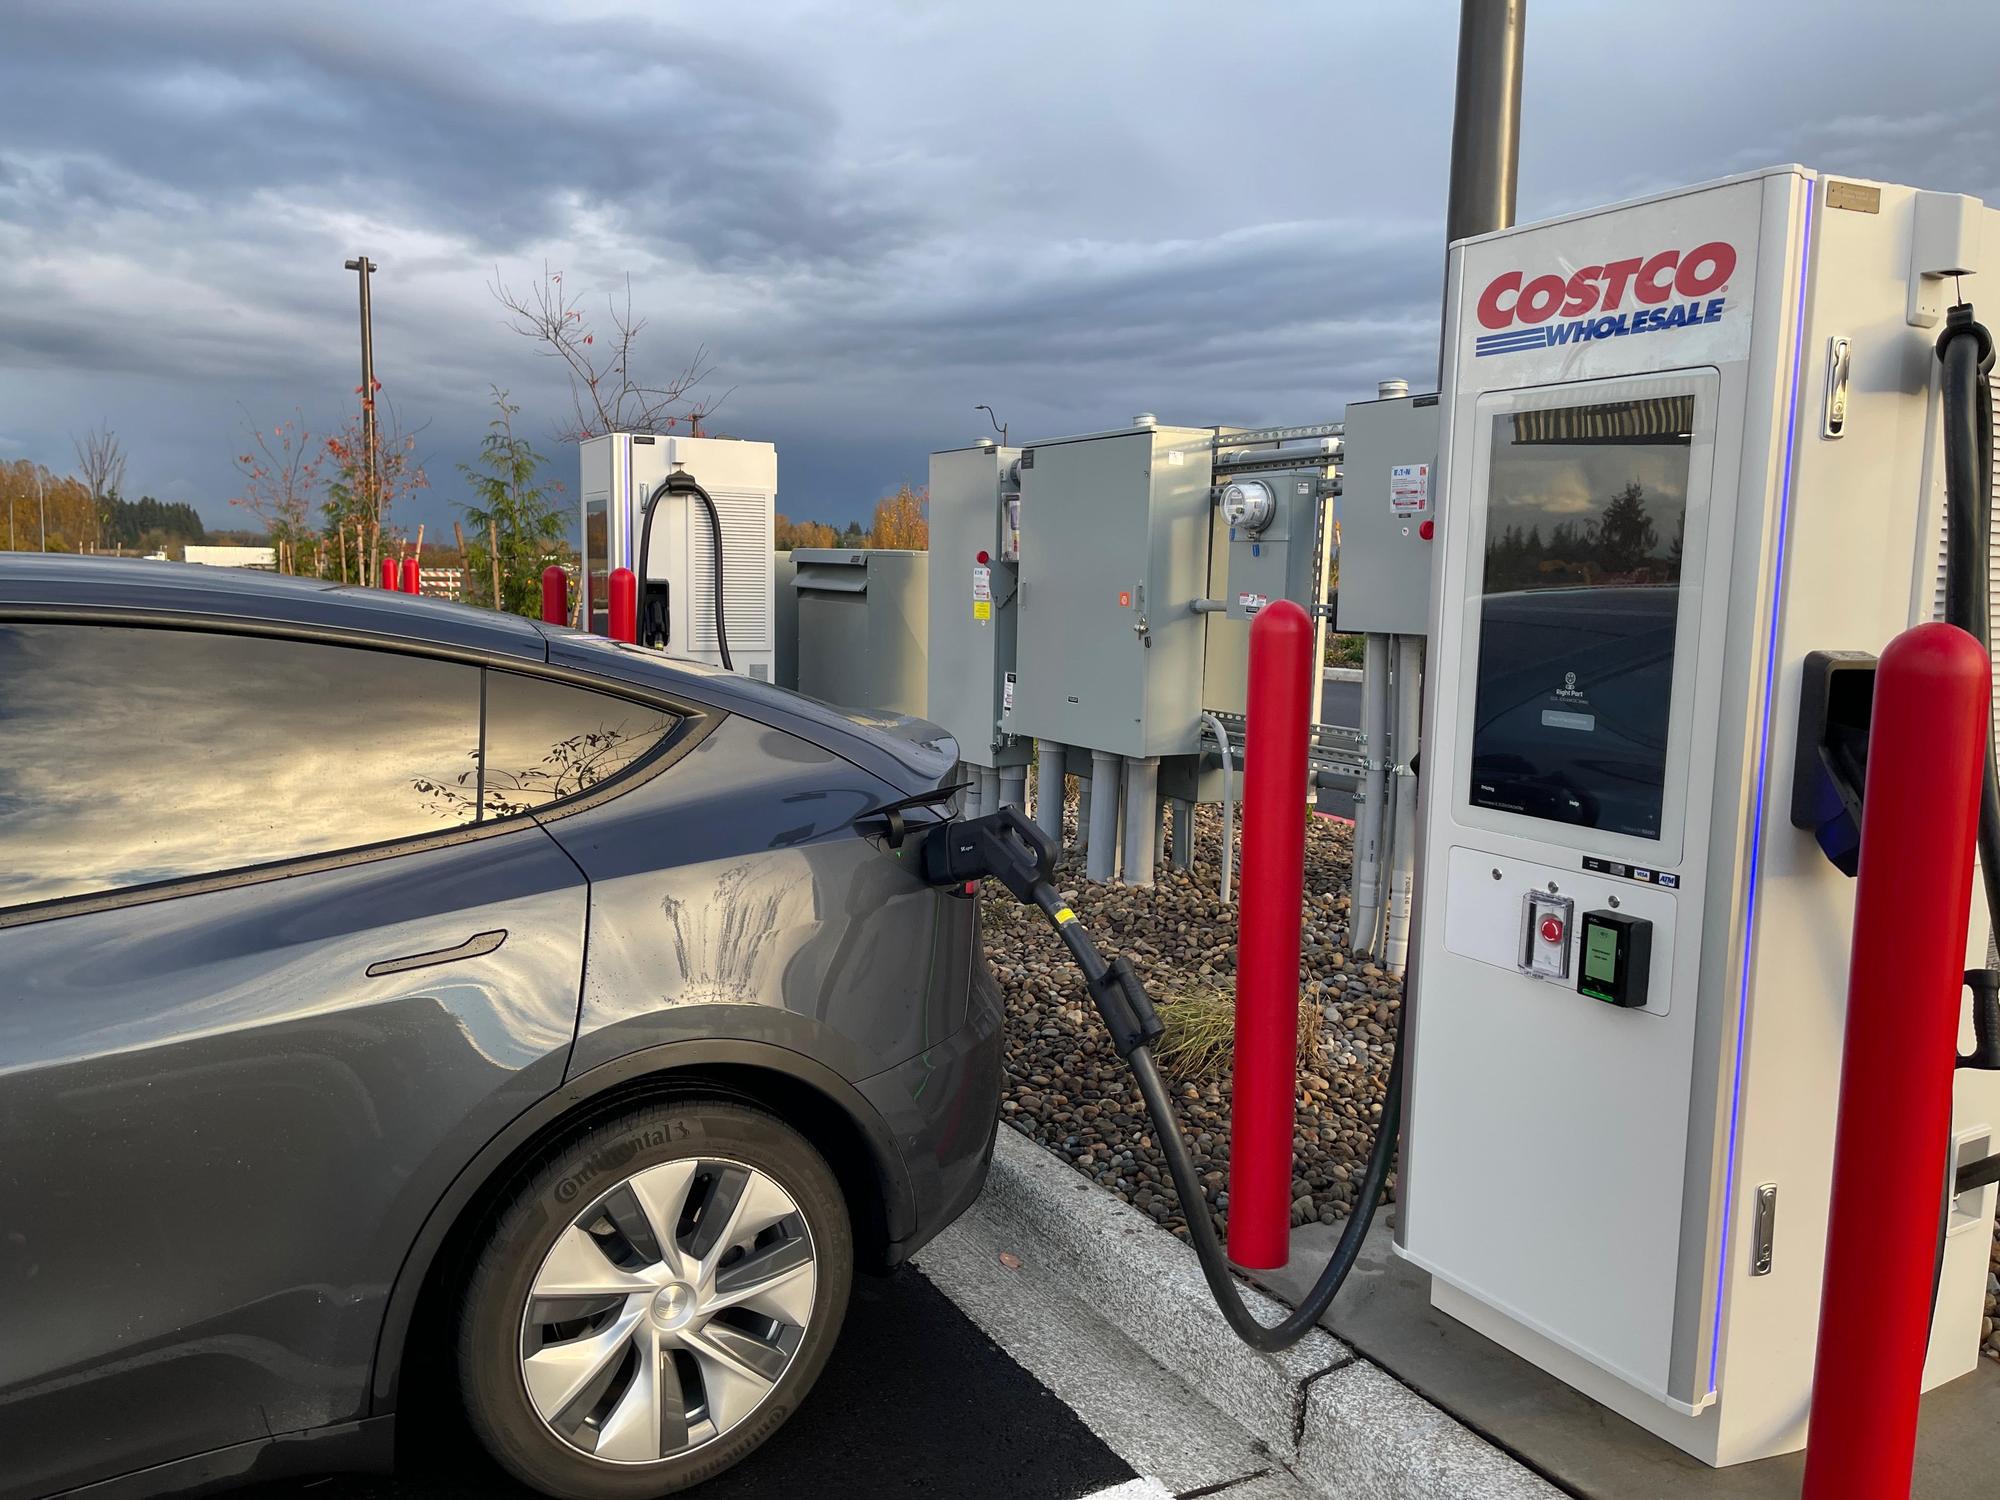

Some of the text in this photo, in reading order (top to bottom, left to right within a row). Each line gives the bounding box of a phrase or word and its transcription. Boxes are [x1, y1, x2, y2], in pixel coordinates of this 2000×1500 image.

[1477, 241, 1737, 330] COSTCO
[1546, 298, 1725, 346] WHOLESALE
[1636, 870, 1648, 879] VISA
[1659, 875, 1675, 885] ATM
